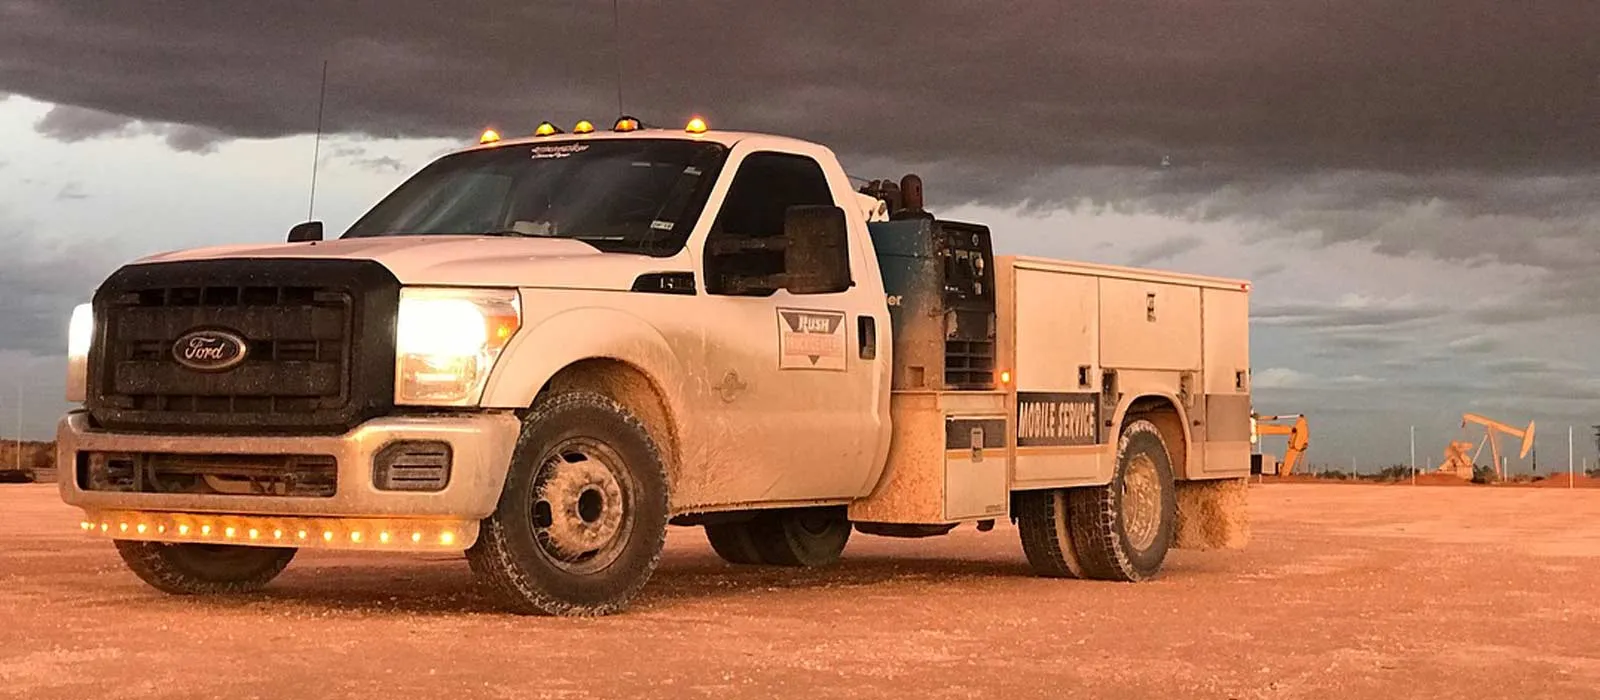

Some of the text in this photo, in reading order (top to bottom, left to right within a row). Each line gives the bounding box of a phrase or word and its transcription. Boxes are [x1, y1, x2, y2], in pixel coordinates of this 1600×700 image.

[798, 314, 830, 333] RUSH
[185, 337, 225, 360] Ford
[1018, 402, 1095, 438] MOBILE SERVICE
